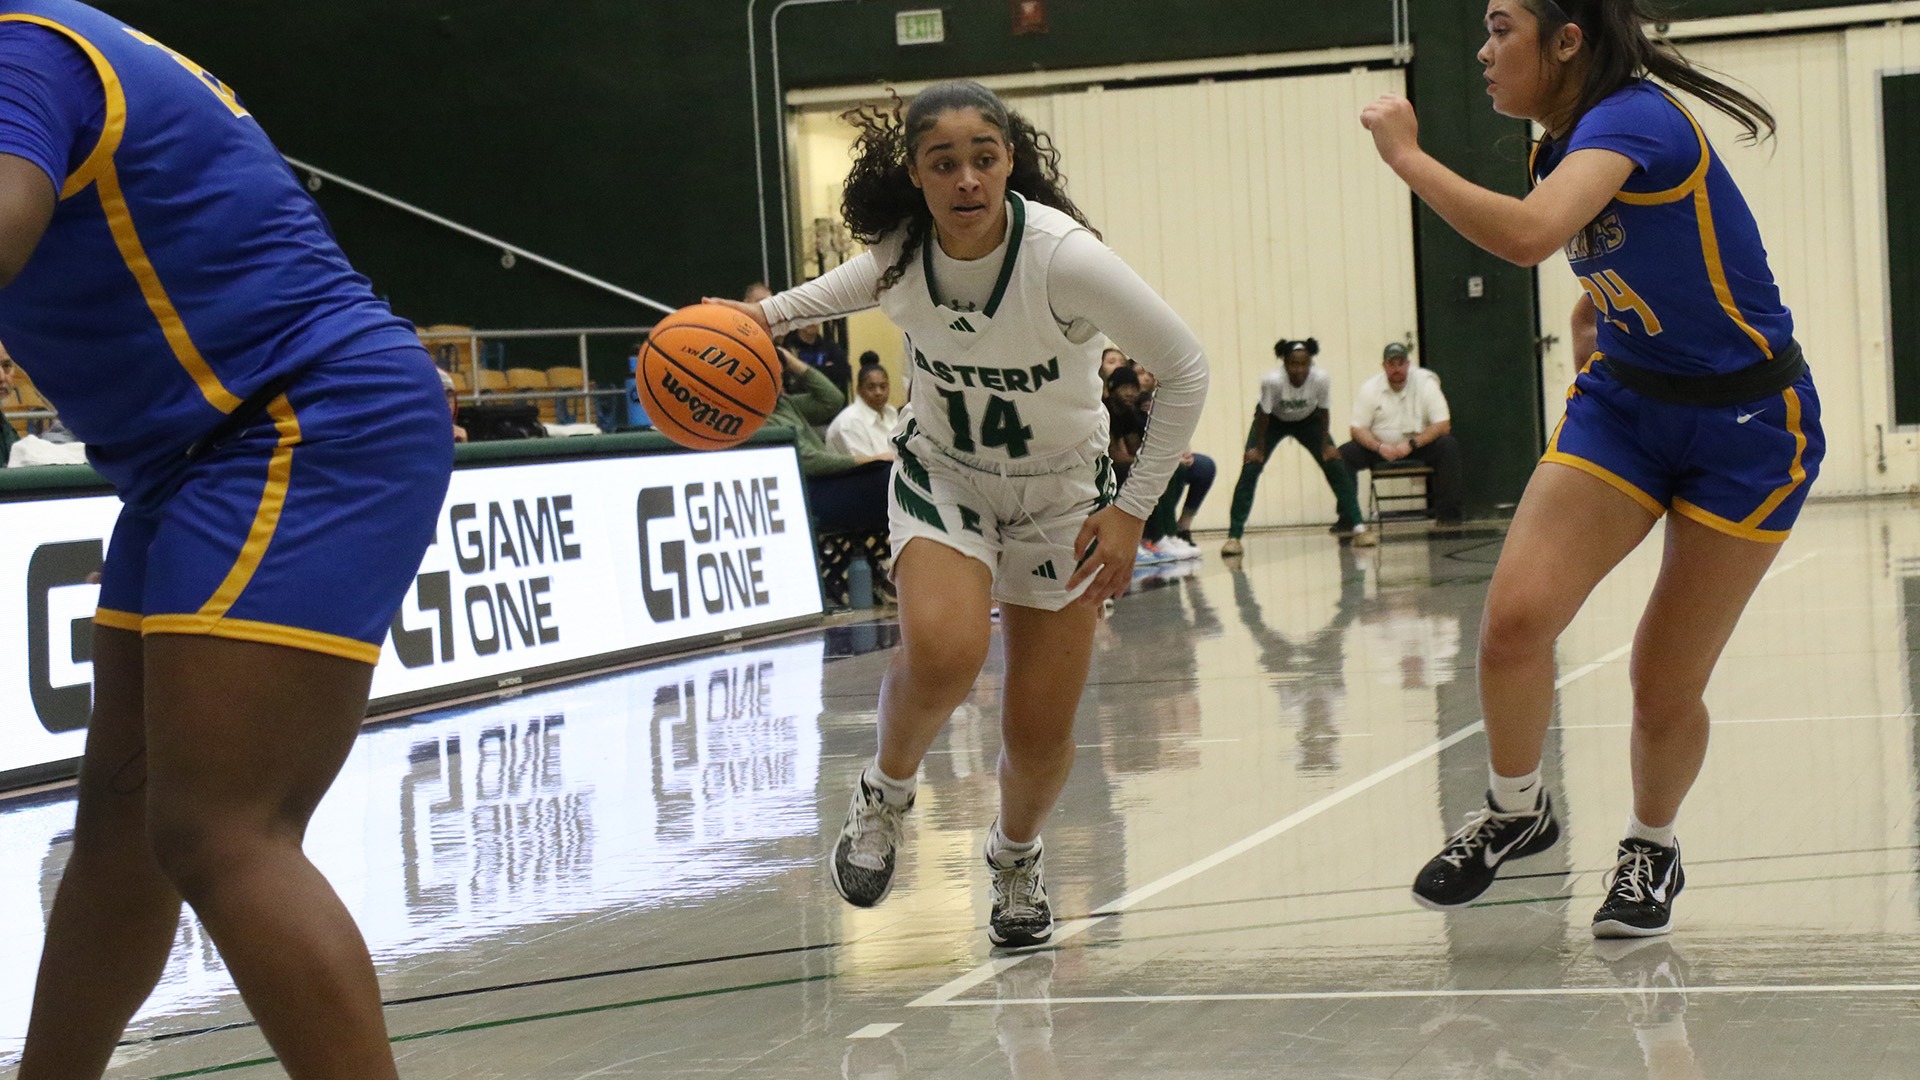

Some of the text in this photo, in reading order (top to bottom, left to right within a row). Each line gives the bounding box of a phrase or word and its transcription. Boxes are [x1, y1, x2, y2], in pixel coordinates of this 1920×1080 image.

[905, 13, 939, 39] EXIT
[661, 371, 744, 436] Wilson
[914, 347, 1060, 394] ASTERN
[935, 383, 1032, 458] 14
[450, 494, 581, 575] GAME
[684, 476, 785, 544] GAME
[697, 547, 769, 615] ONE
[464, 576, 559, 657] ONE
